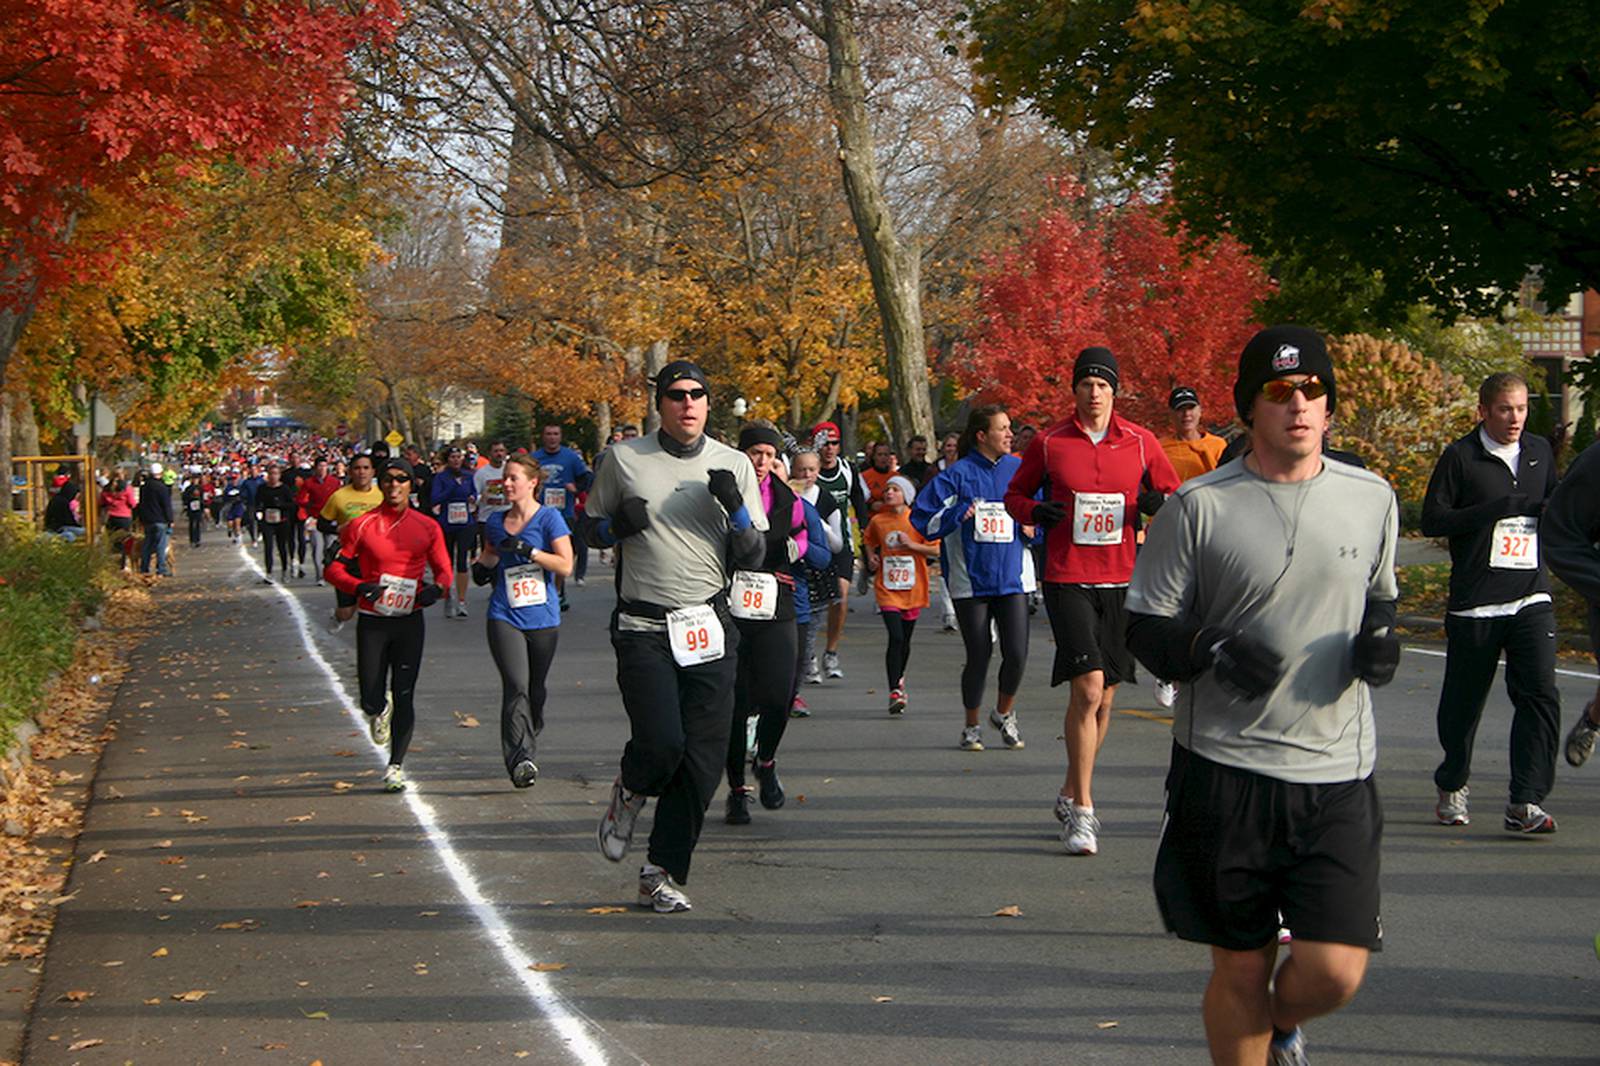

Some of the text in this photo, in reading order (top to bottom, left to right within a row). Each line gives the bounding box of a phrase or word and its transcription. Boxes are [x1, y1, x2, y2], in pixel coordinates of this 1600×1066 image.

[982, 518, 1005, 534] 301
[1083, 513, 1115, 534] 786
[1500, 536, 1529, 557] 327
[512, 579, 539, 599] 562
[743, 590, 763, 609] 98
[686, 627, 709, 652] 99
